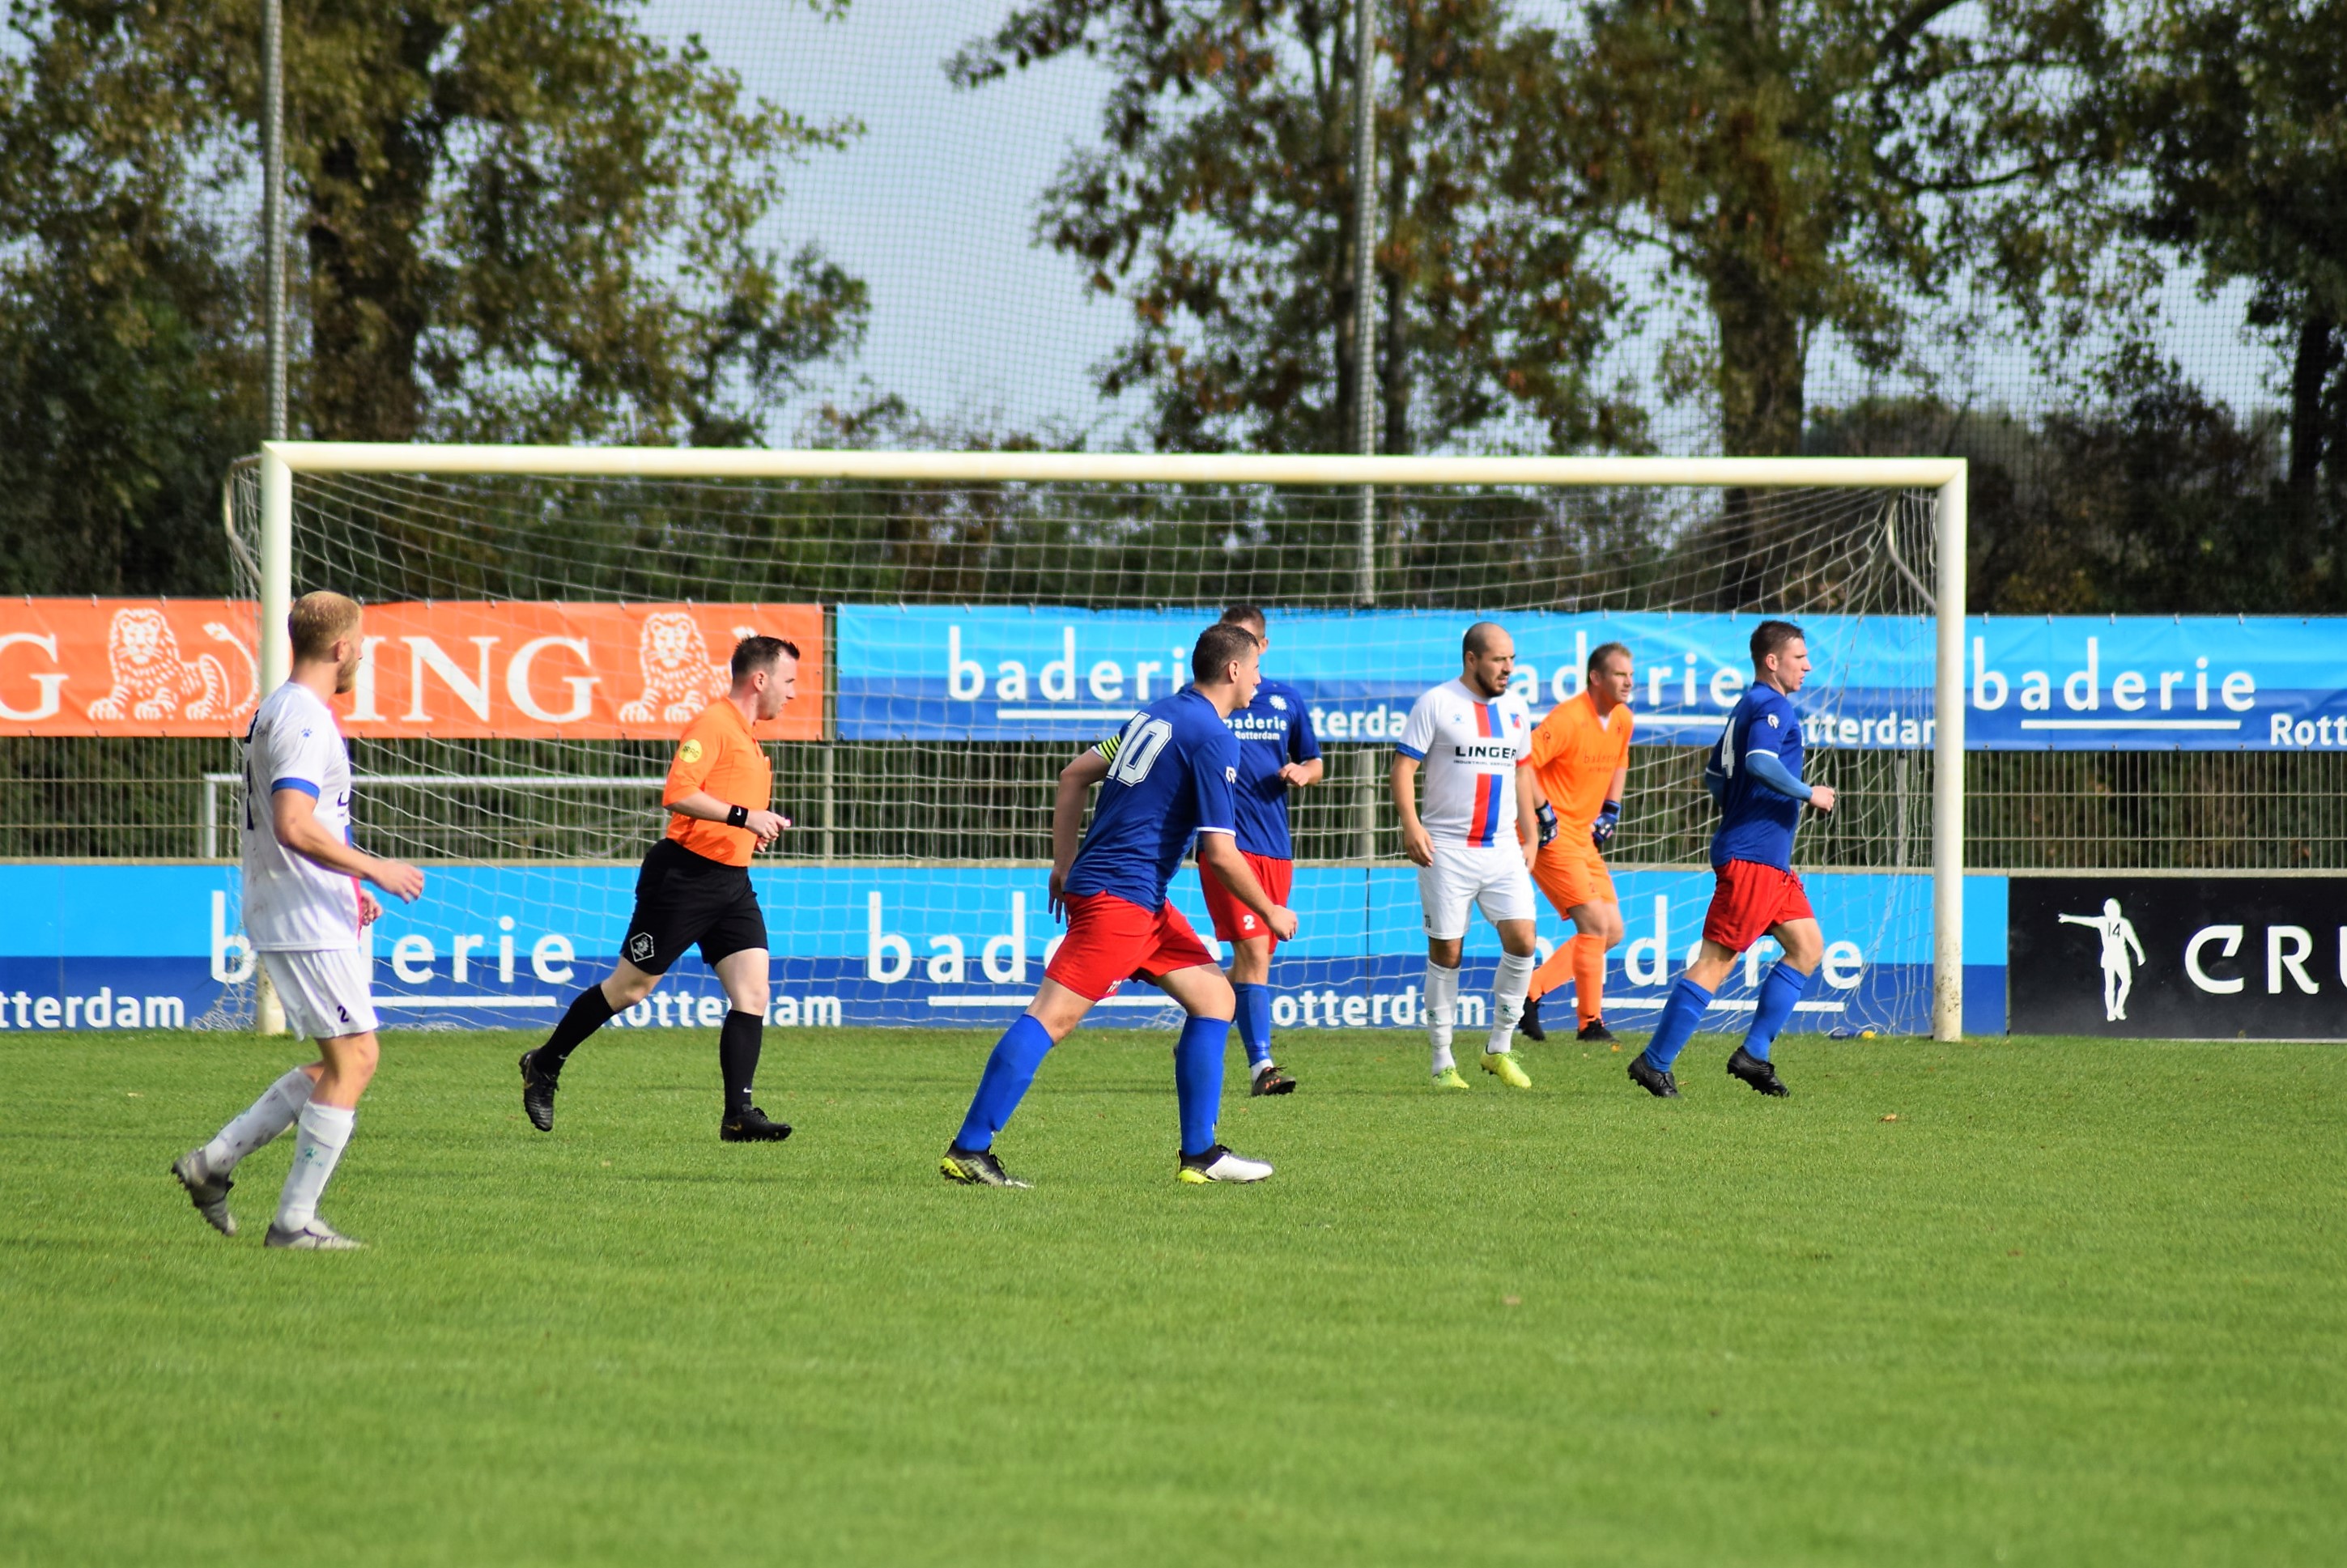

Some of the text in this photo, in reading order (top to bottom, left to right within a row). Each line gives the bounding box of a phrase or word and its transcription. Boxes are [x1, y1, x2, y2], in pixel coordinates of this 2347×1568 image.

[342, 635, 601, 723] ING
[949, 625, 1185, 701] baderi
[1973, 636, 2256, 712] baderie
[1106, 712, 1172, 788] 10
[1235, 730, 1280, 740] Rotterdam
[1721, 716, 1736, 779] 4
[210, 890, 575, 984] berie
[1243, 914, 1255, 931] 2
[2107, 922, 2121, 938] 14
[2184, 924, 2347, 995] CR
[336, 1005, 350, 1023] 2
[1271, 985, 1486, 1026] otterdm
